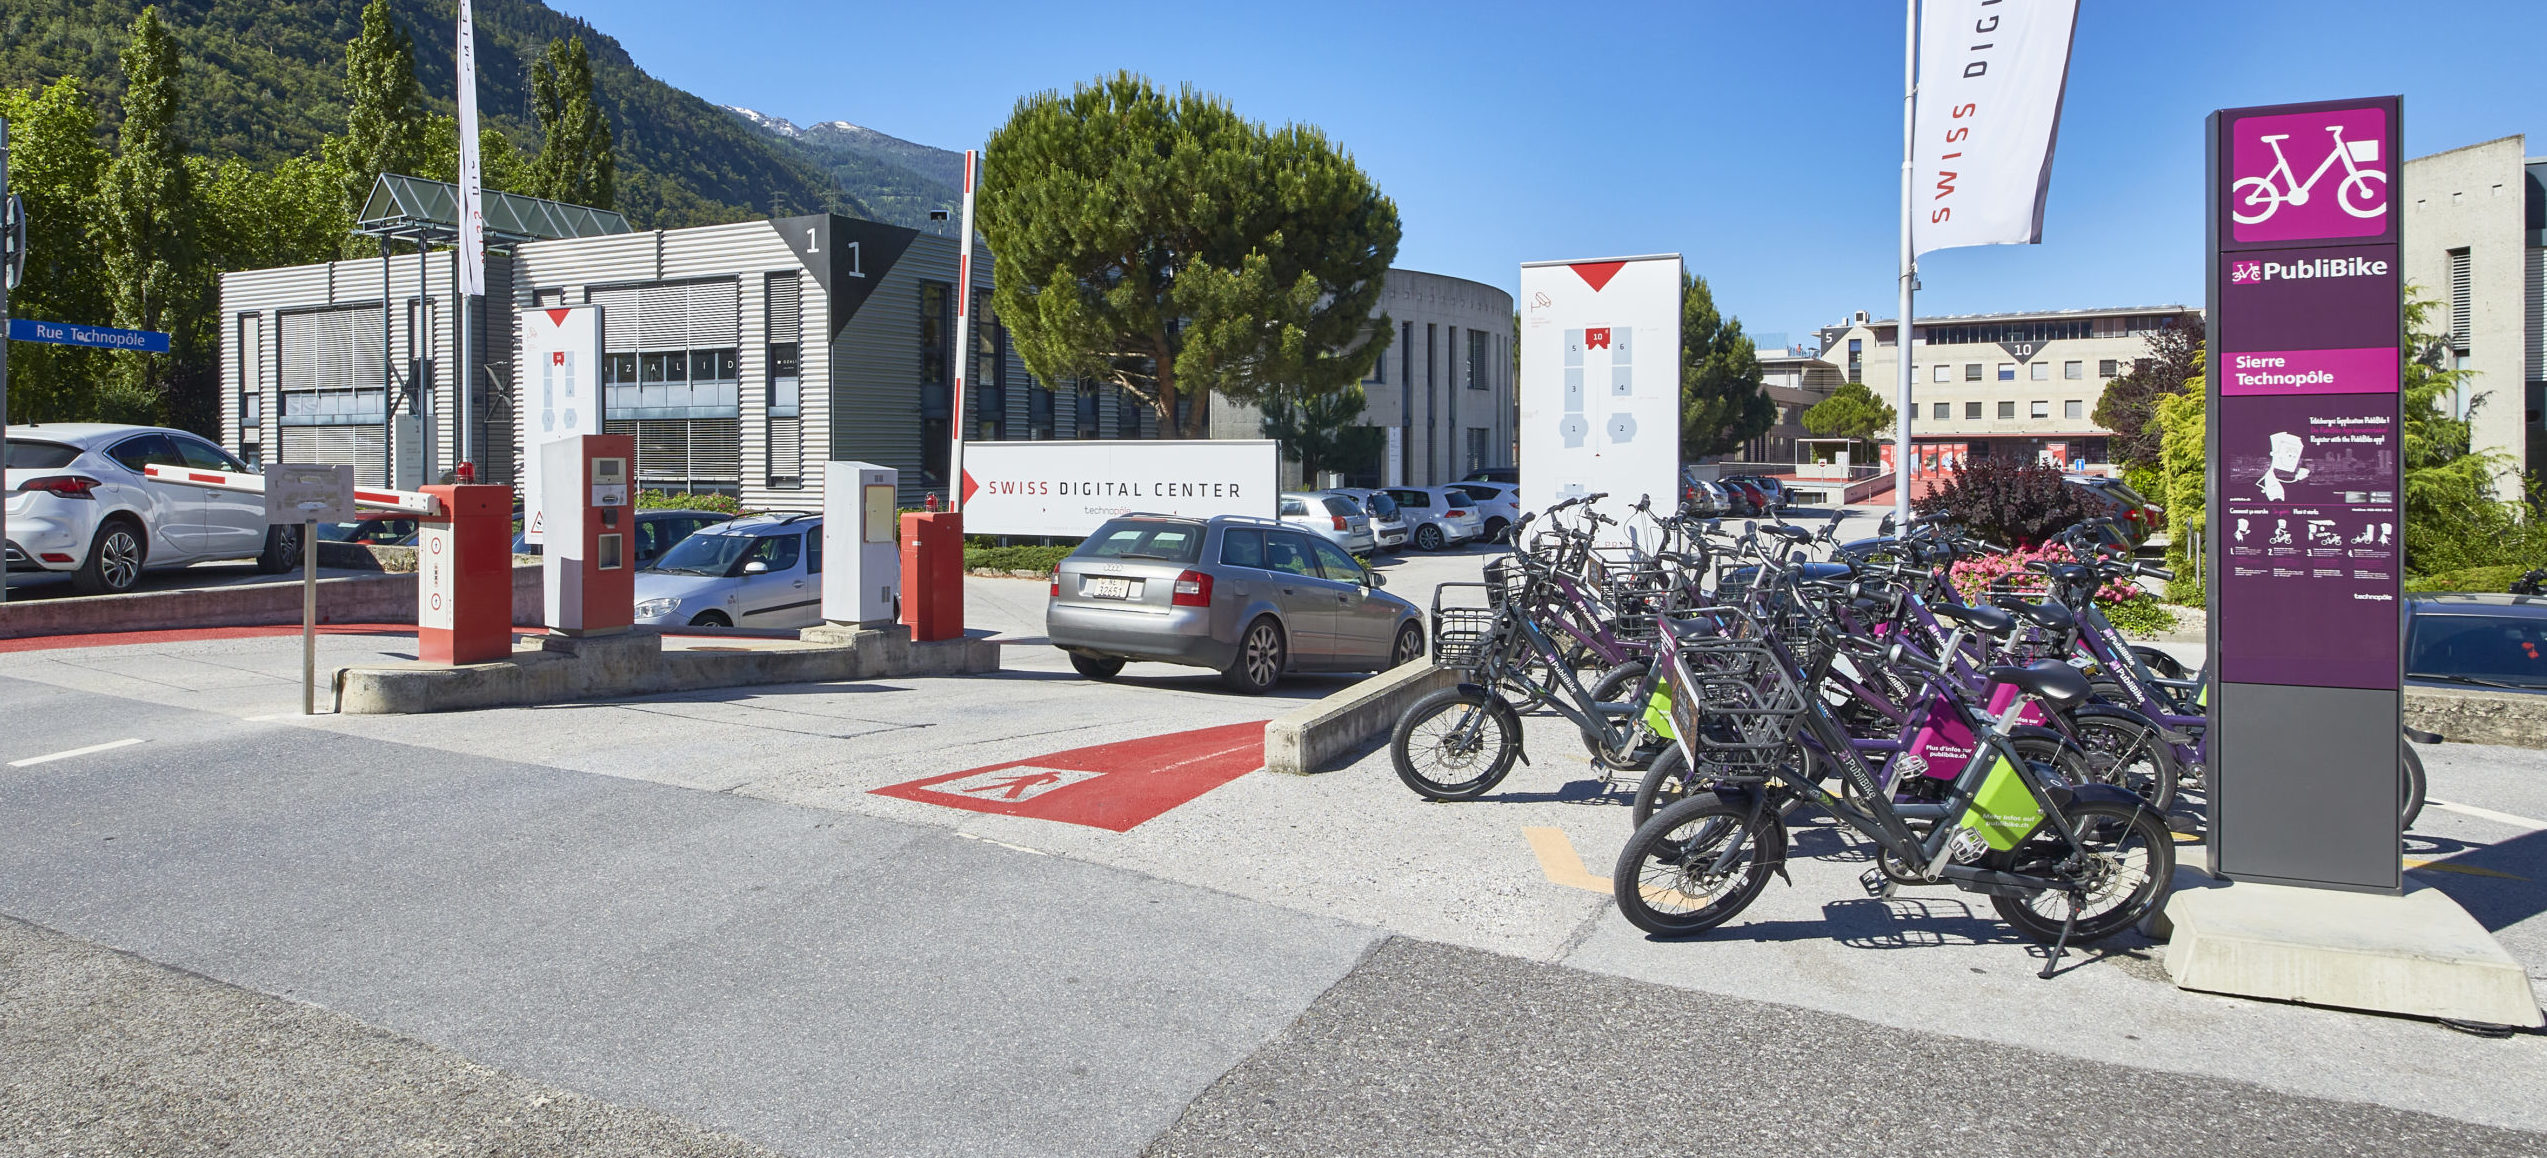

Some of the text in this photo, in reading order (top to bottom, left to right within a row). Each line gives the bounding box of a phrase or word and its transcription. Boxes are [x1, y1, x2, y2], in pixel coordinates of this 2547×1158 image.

[1931, 103, 1976, 224] SWISS
[806, 227, 820, 253] 1
[848, 242, 865, 278] 1
[2264, 256, 2388, 280] PubliBike
[36, 324, 145, 348] Rue Technopôle
[1593, 333, 1603, 341] 10
[2014, 344, 2032, 356] 10
[2236, 355, 2286, 369] Sierre
[2235, 371, 2334, 387] Technopôle
[989, 481, 1240, 498] SWISS DIGITAL CENTER
[2109, 635, 2136, 668] PubliBike
[1551, 661, 1578, 695] PubliBike
[2116, 667, 2146, 705] PubliBike
[1930, 751, 1967, 759] publibike.ch
[1846, 757, 1877, 801] PubliBike
